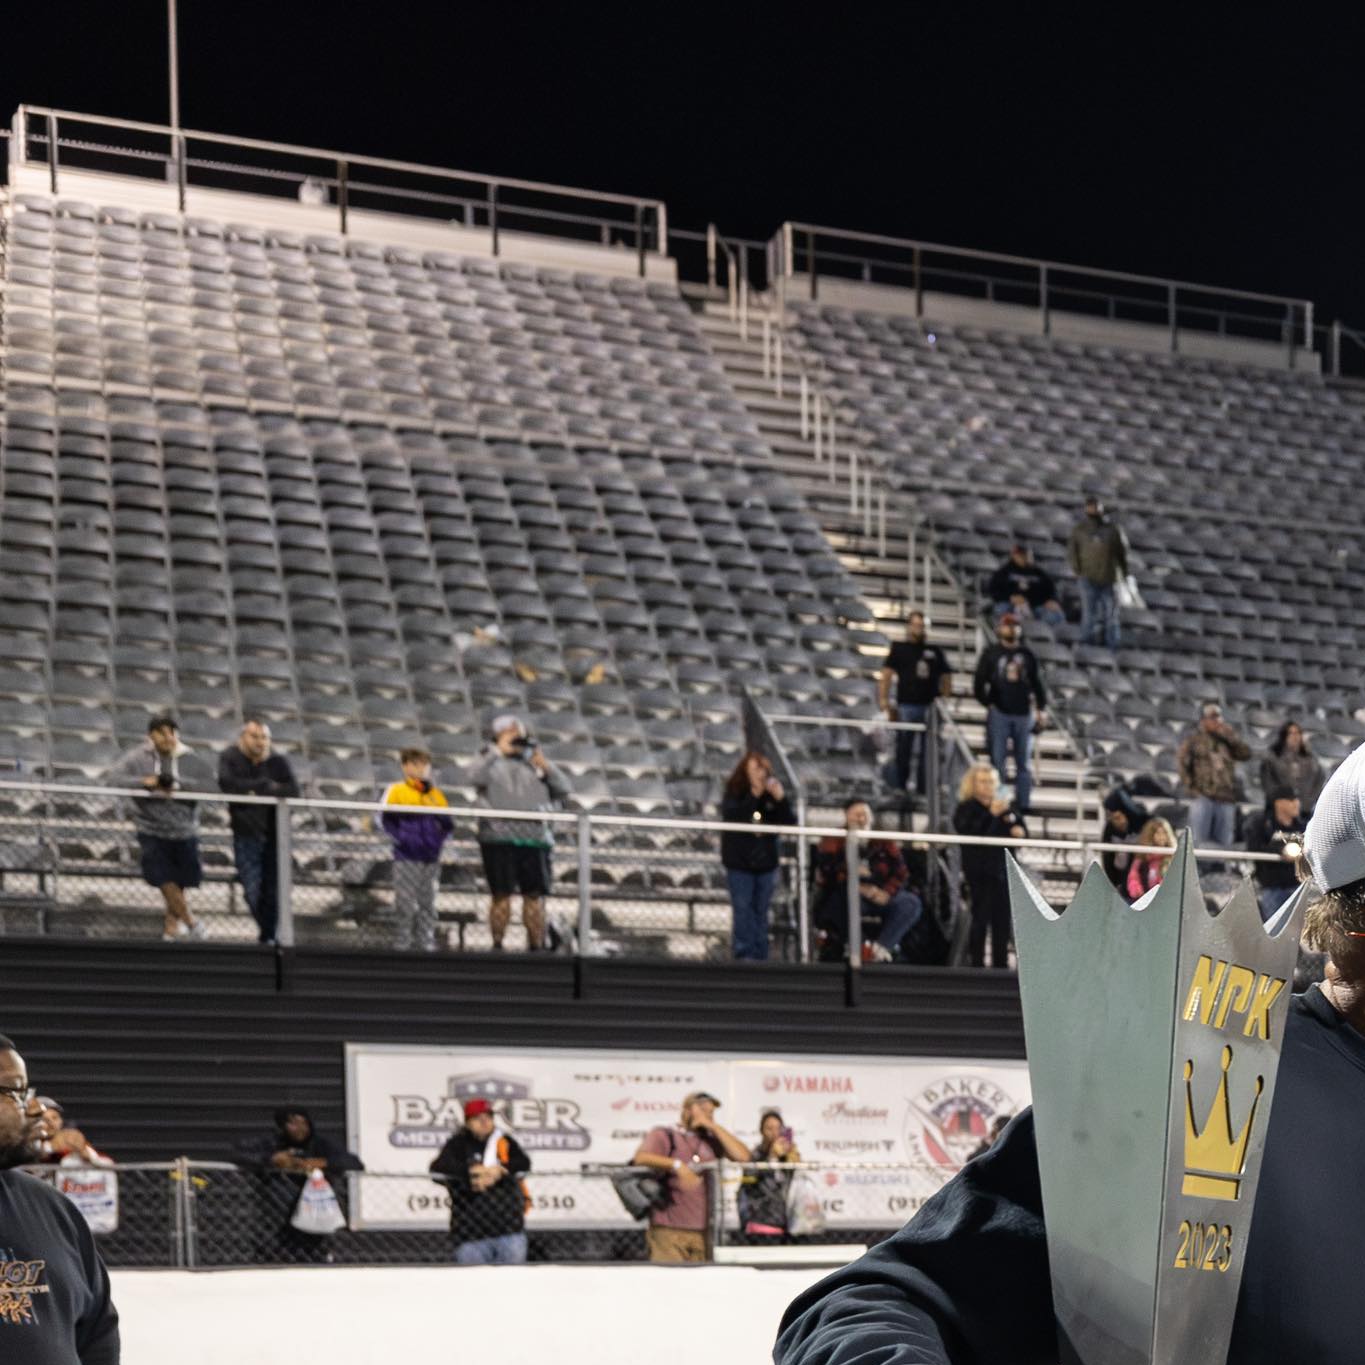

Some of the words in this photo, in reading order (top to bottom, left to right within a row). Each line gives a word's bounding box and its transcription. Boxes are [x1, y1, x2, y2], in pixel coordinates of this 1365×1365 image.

[1183, 954, 1287, 1041] NPK
[784, 1075, 854, 1093] YAMAHA
[923, 1079, 1004, 1107] BAKER
[391, 1095, 581, 1132] BAKER
[815, 1139, 880, 1151] TRIUMPH
[844, 1174, 911, 1186] SUZUKI
[1173, 1219, 1233, 1273] 2023
